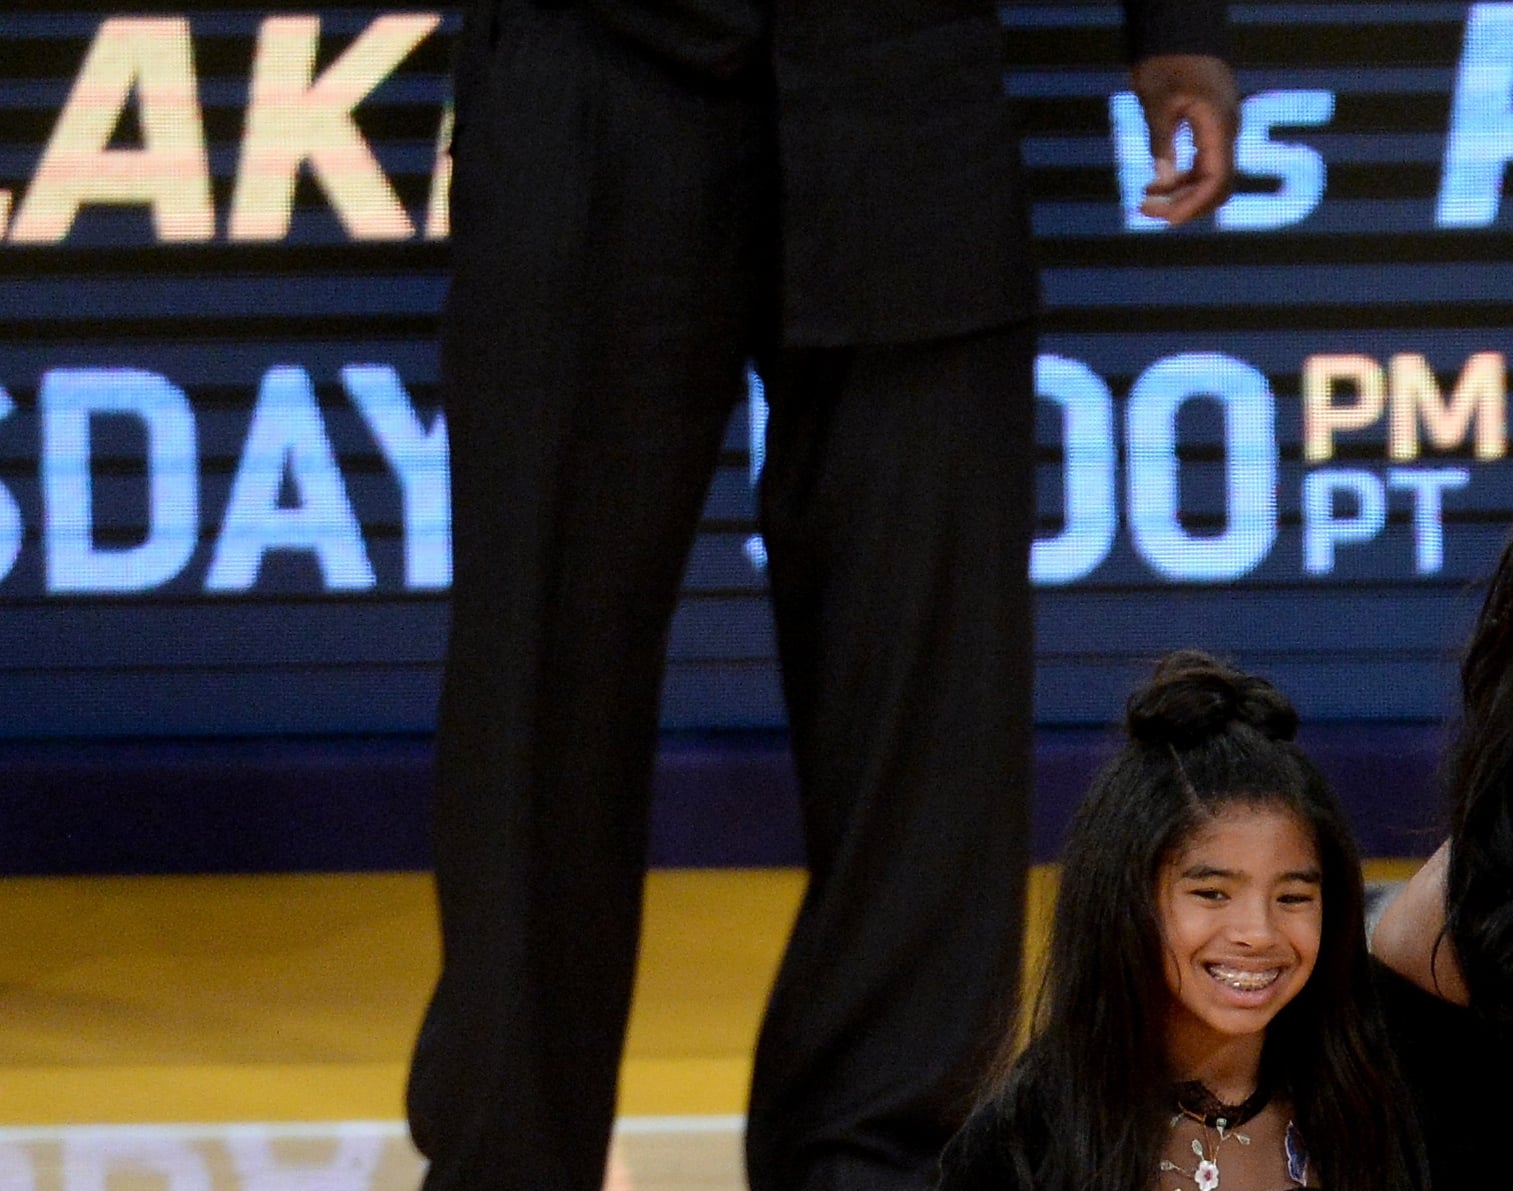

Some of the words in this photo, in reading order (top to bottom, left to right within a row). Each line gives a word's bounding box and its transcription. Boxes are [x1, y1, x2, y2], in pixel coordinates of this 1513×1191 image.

[0, 15, 451, 242] AK
[1303, 352, 1508, 462] PM
[1302, 467, 1470, 575] PT
